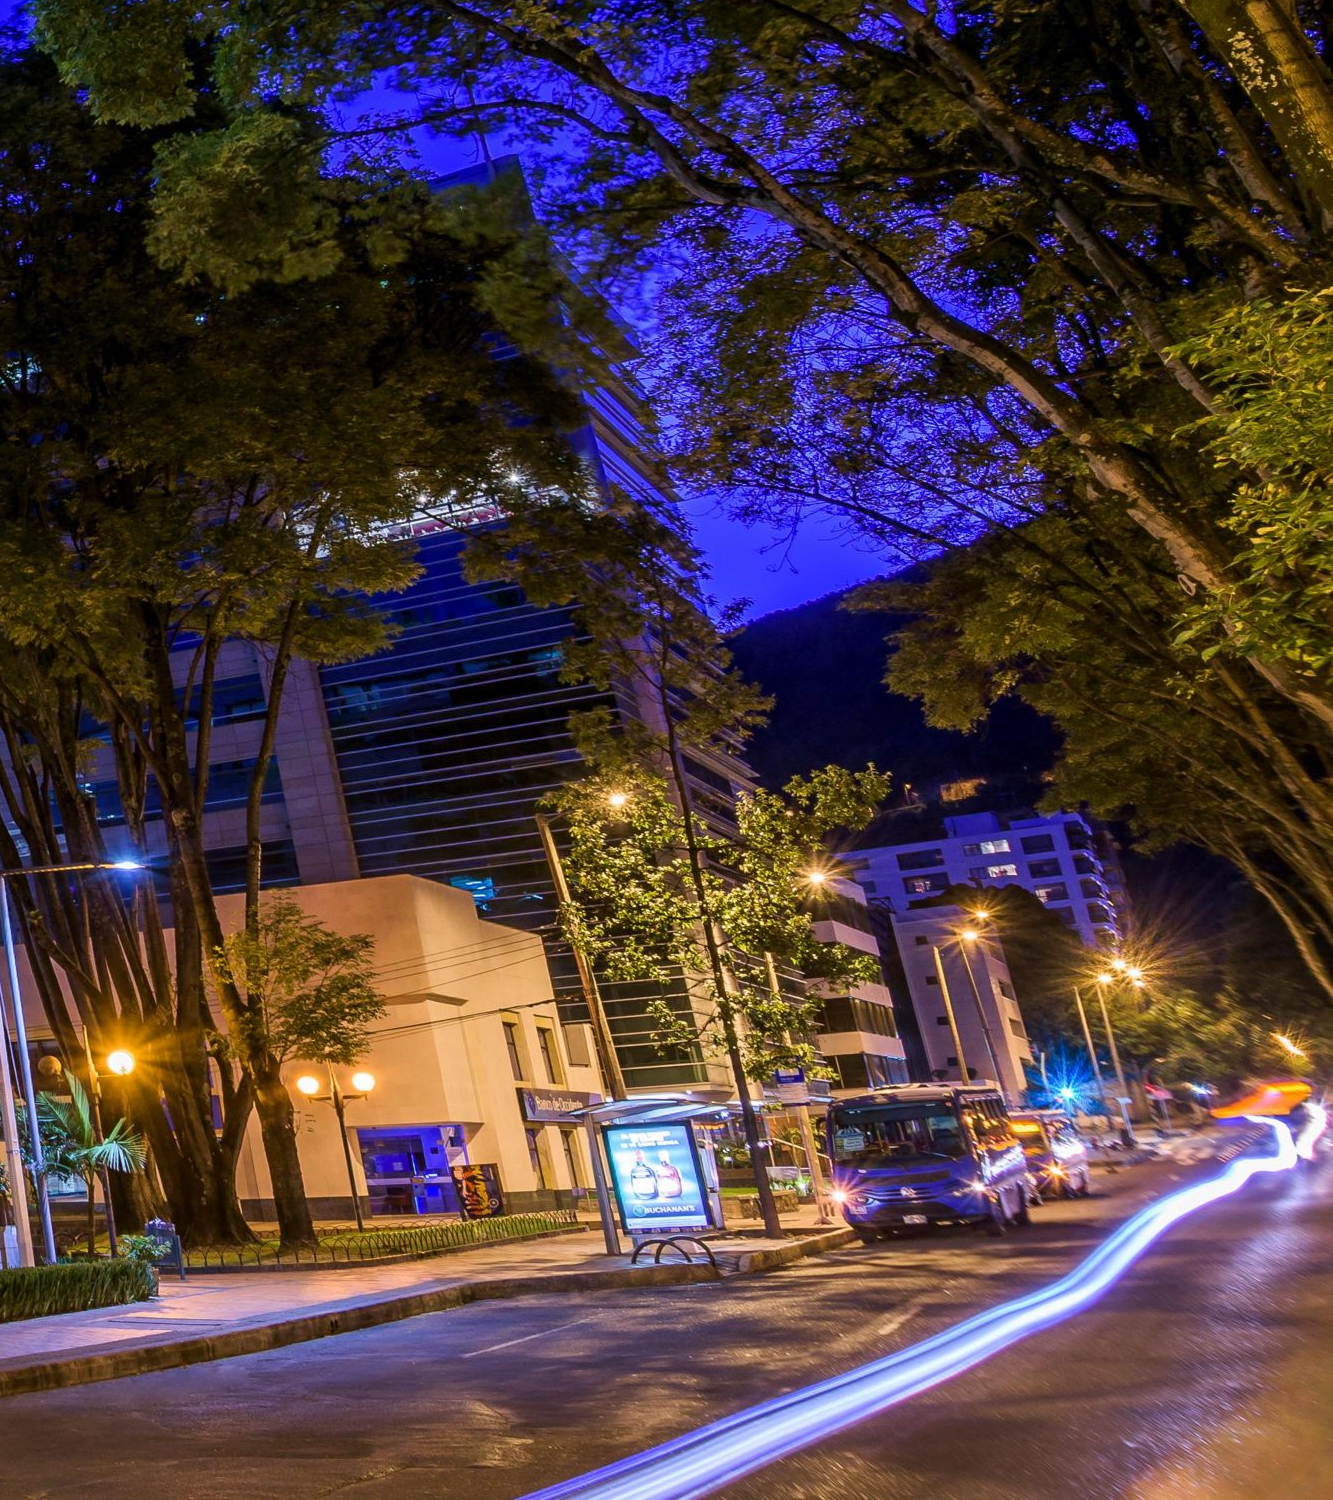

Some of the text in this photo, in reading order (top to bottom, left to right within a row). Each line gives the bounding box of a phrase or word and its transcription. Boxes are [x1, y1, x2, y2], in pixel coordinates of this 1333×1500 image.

[535, 1095, 553, 1111] Banco
[552, 1097, 559, 1112] de
[644, 1204, 696, 1214] BUCHANAN'S
